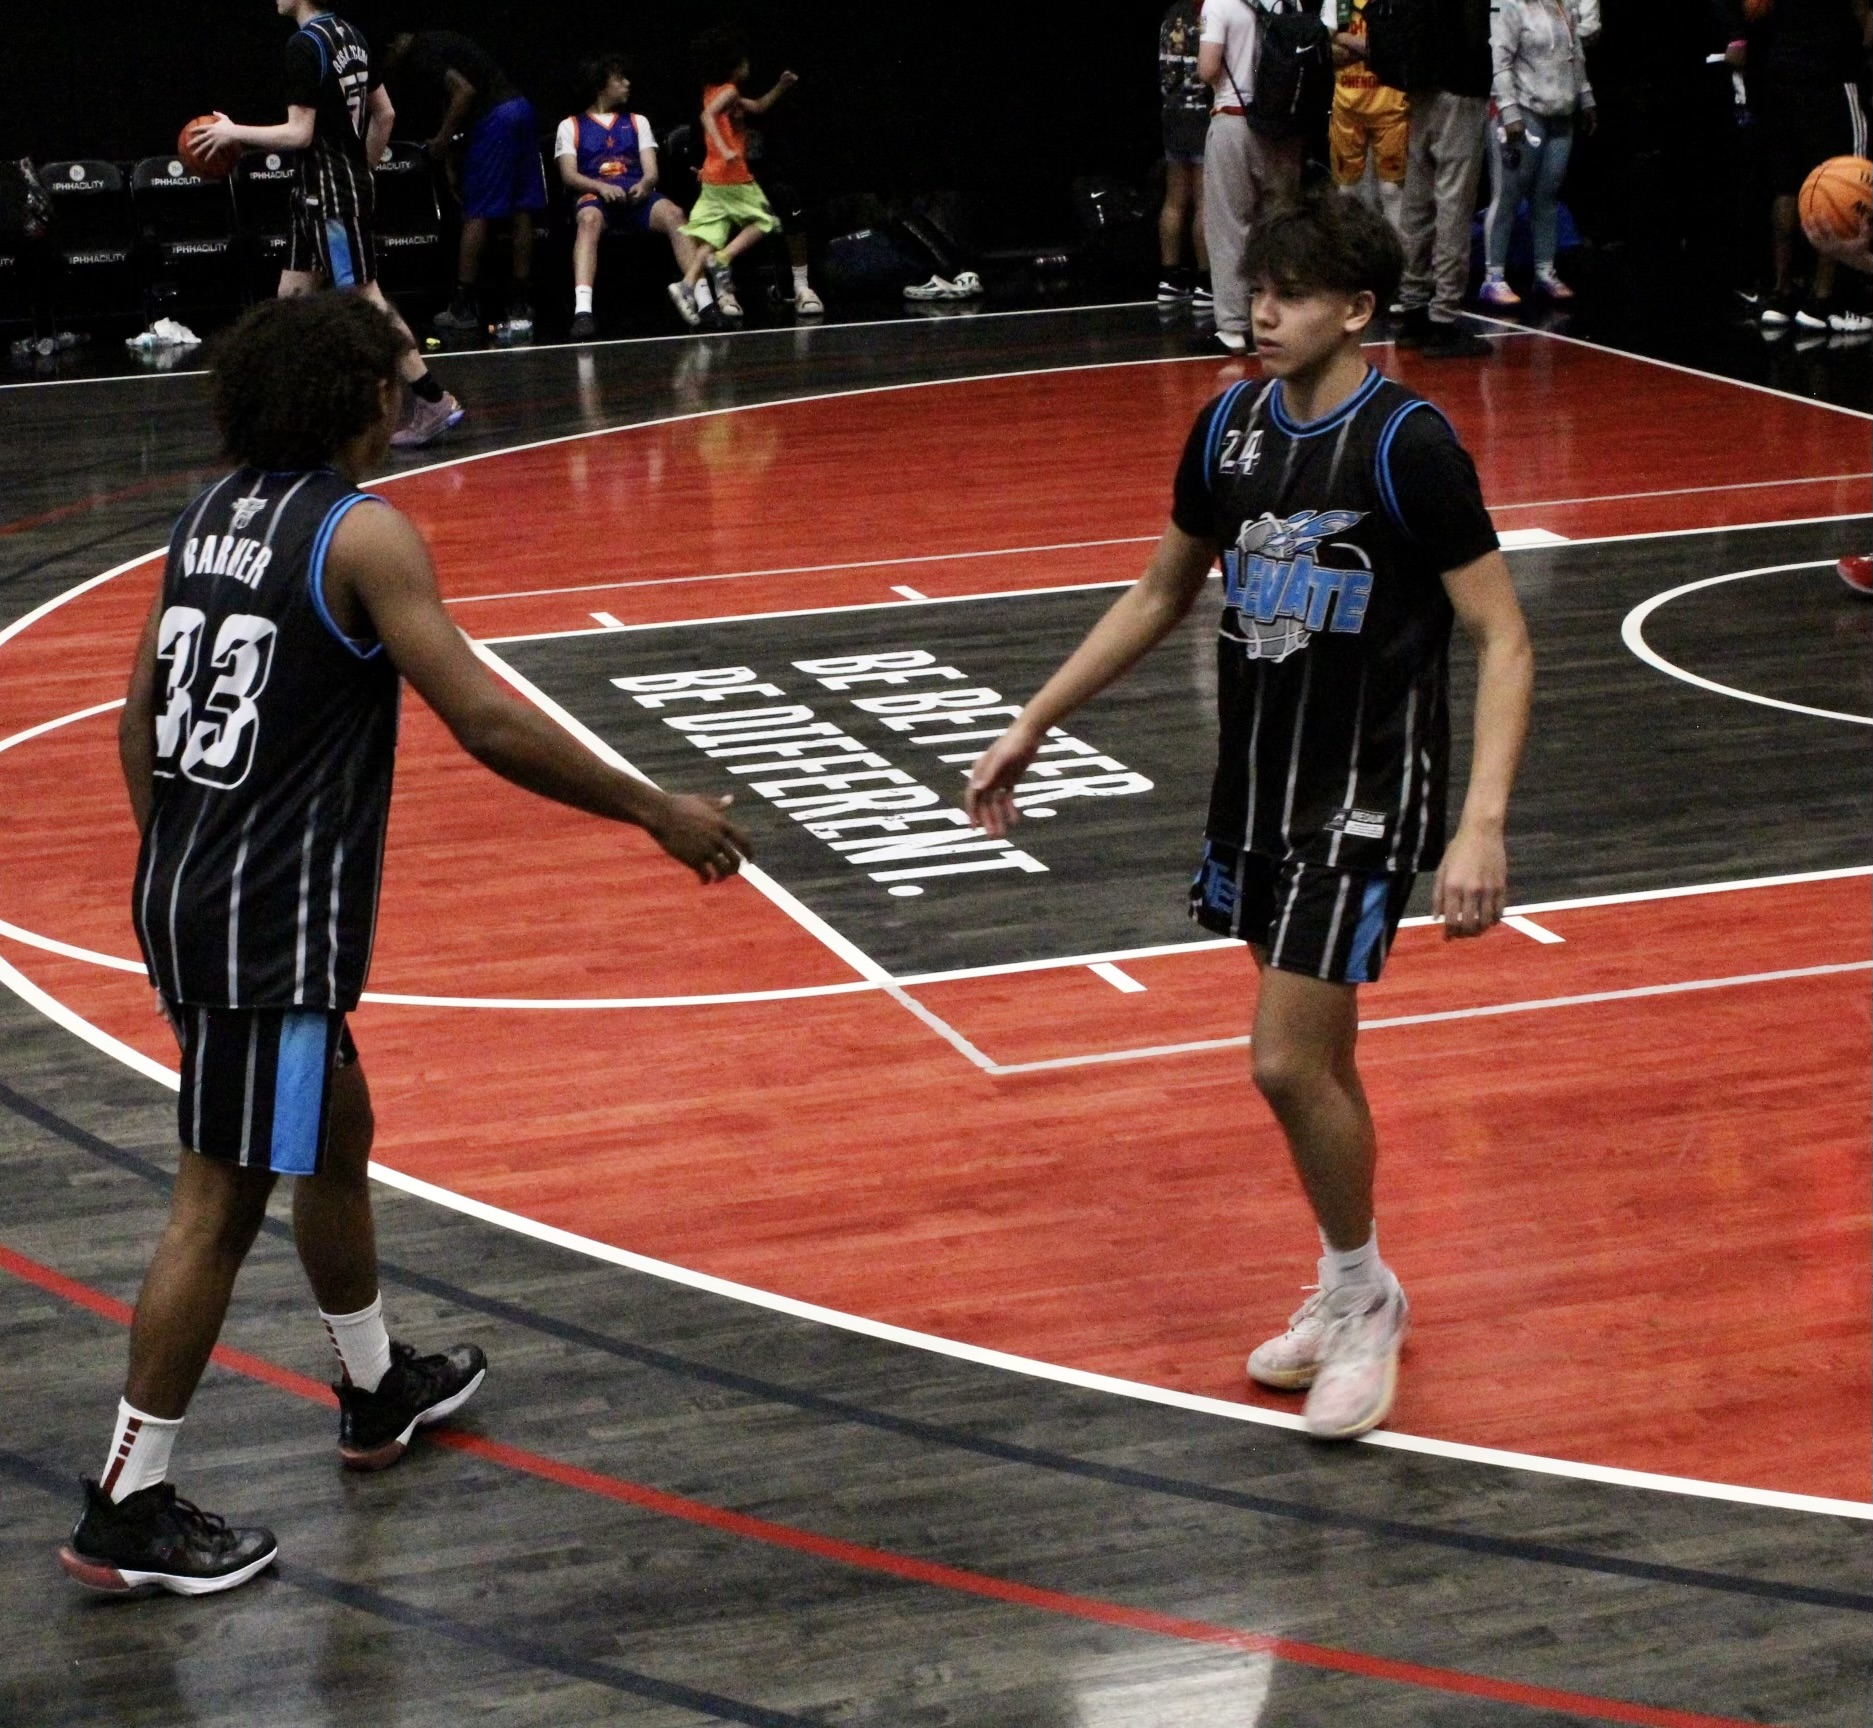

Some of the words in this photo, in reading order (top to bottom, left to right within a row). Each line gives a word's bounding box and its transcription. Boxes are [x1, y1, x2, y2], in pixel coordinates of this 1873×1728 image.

[1219, 429, 1264, 475] 24
[1224, 549, 1374, 634] LEVATE
[609, 666, 786, 709] BE
[791, 650, 968, 691] BE
[153, 605, 278, 790] 33
